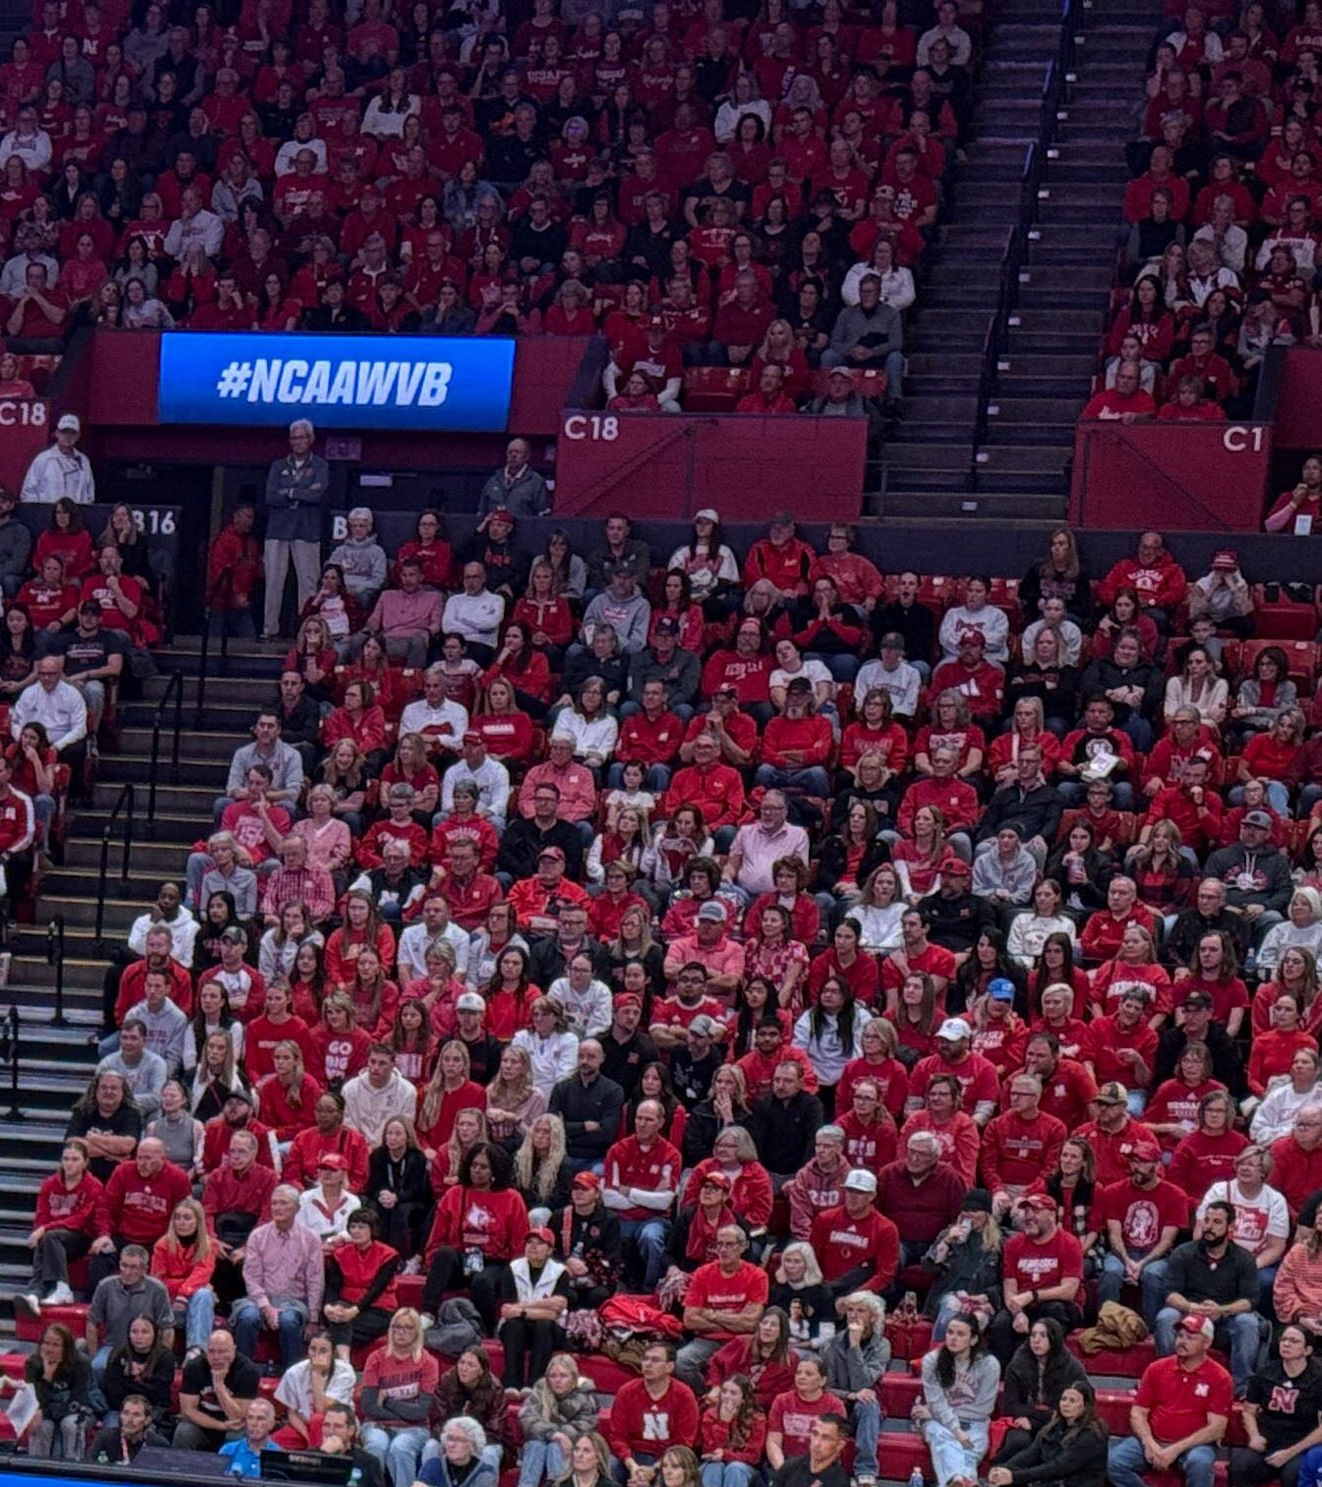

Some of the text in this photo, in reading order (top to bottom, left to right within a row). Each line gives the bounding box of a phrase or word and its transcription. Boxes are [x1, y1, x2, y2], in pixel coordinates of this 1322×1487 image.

[216, 357, 452, 407] #NCAAWVB
[565, 416, 619, 440] C18
[1223, 426, 1263, 452] C1
[1268, 1386, 1300, 1413] N
[642, 1413, 670, 1440] N
